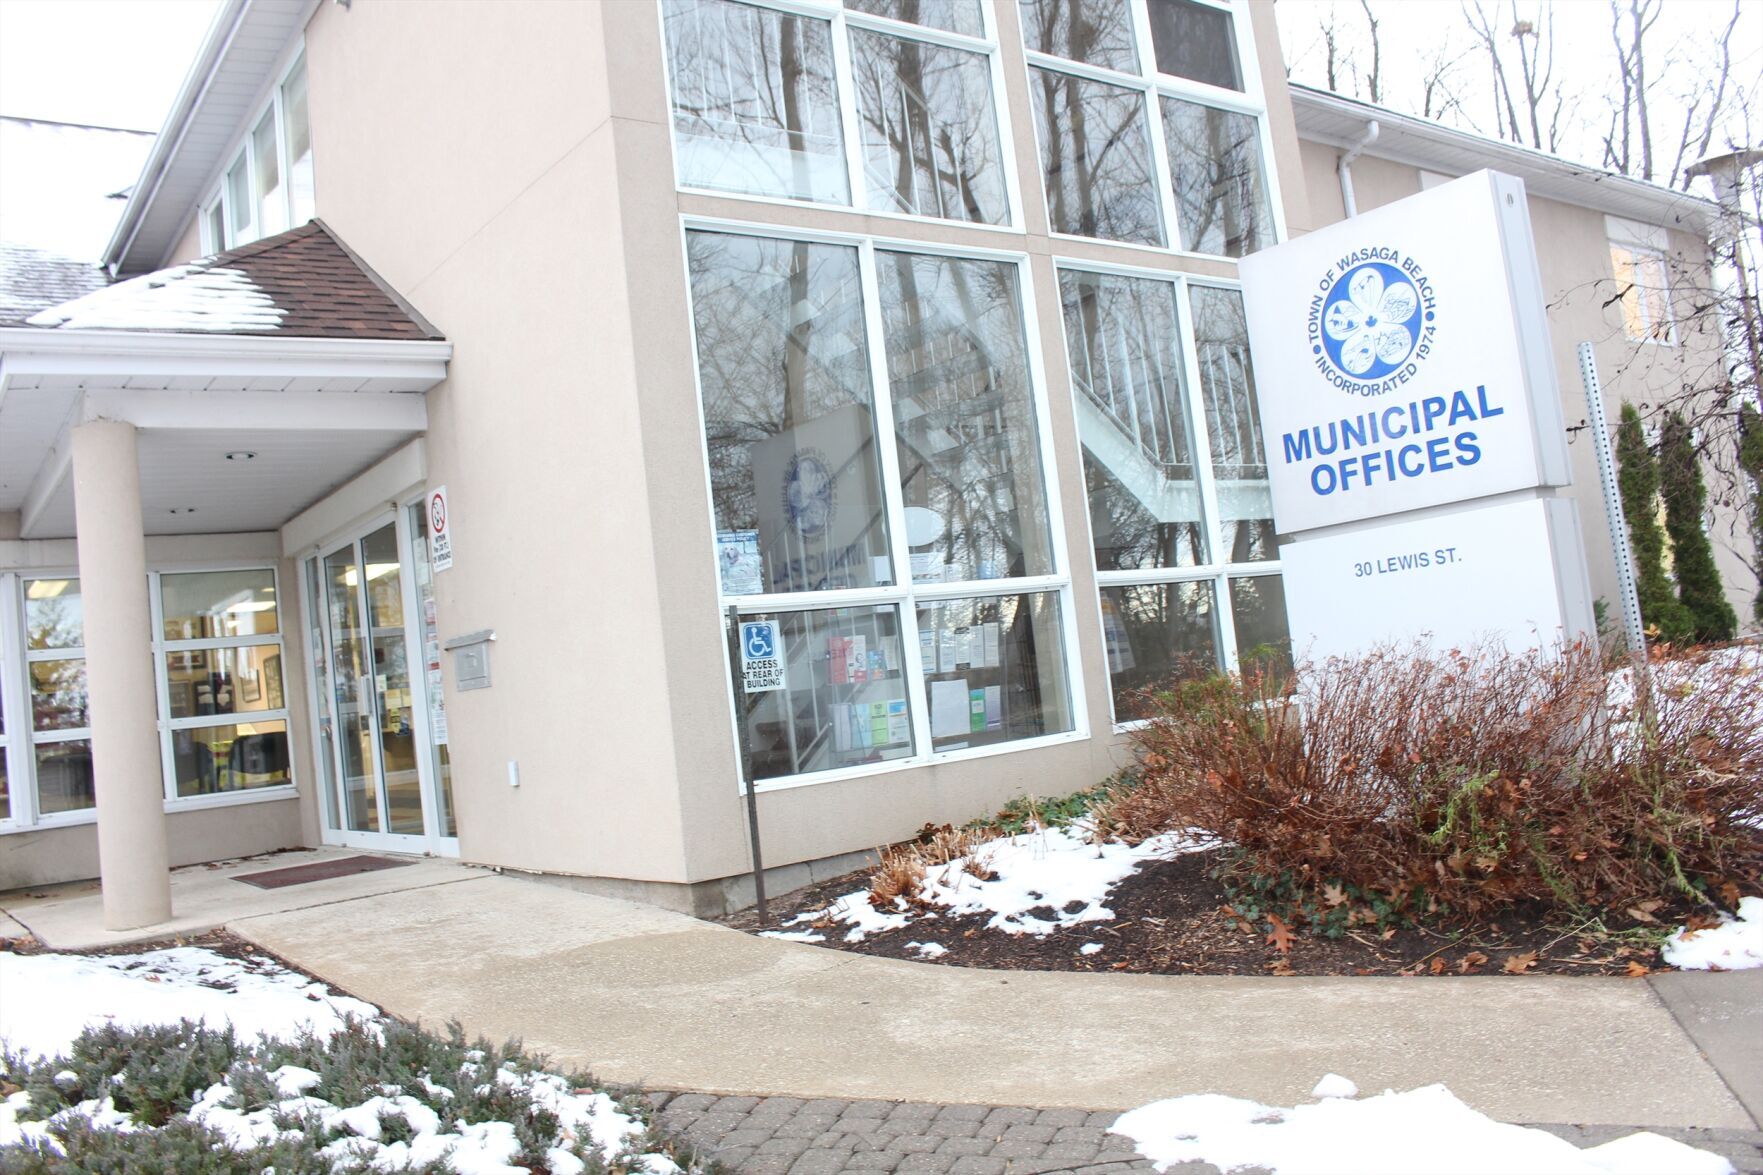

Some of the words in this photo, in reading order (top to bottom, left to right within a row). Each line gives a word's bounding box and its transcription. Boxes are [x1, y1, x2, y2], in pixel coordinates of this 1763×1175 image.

[1308, 295, 1323, 344] TOWN
[1319, 269, 1335, 291] OF
[1337, 247, 1399, 271] WASAGA
[1402, 257, 1436, 310] BEACH
[1315, 356, 1417, 397] INCORPORATED
[1416, 325, 1436, 360] 1974
[1282, 385, 1504, 464] MUNICIPAL
[1310, 431, 1482, 496] OFFICES
[1354, 561, 1373, 577] 30
[1377, 552, 1430, 574] LEWIS
[1434, 547, 1462, 565] ST.
[742, 671, 750, 680] AT
[753, 670, 773, 679] REAR
[775, 668, 784, 677] OF
[746, 660, 778, 669] ACCESS
[747, 678, 780, 688] BUILDING
